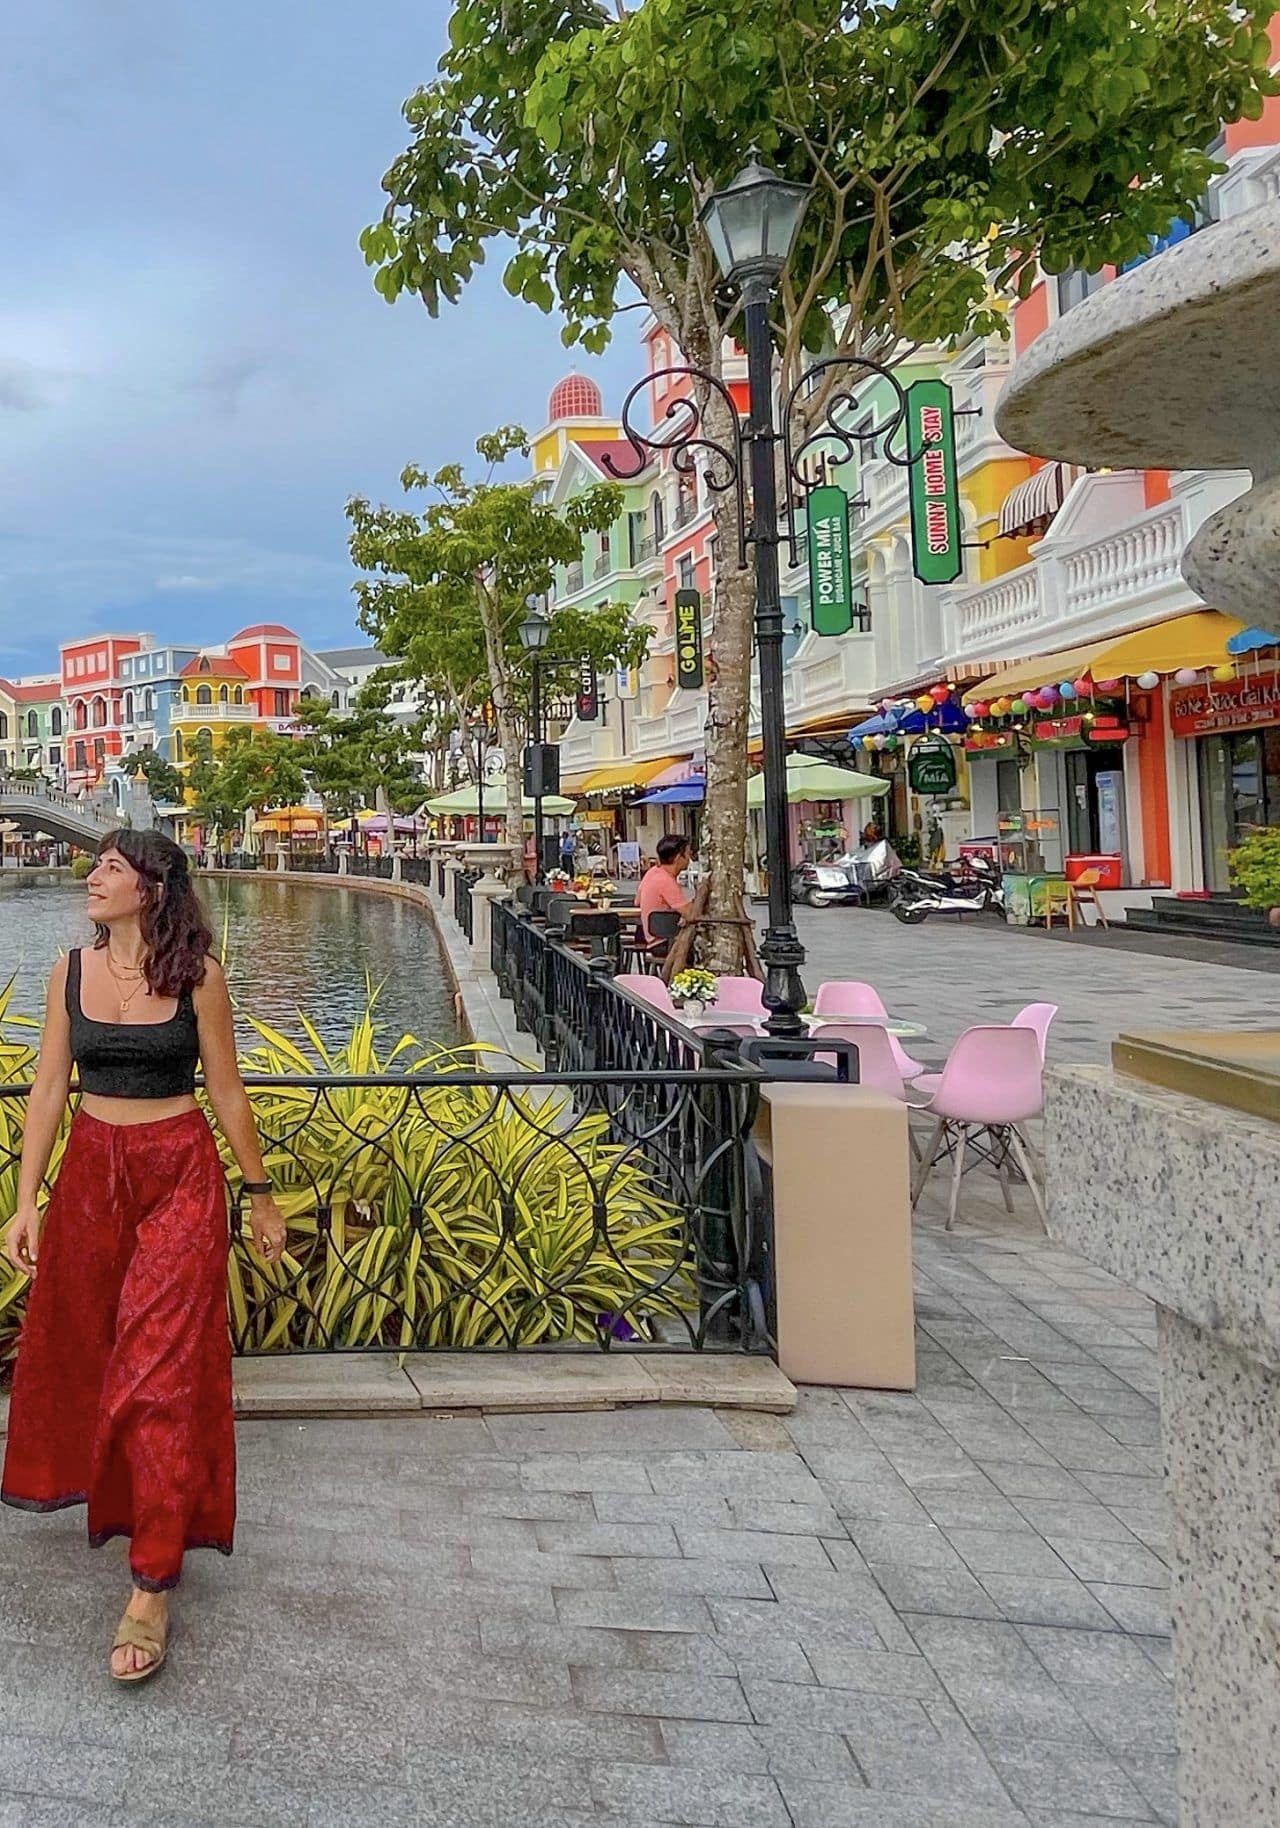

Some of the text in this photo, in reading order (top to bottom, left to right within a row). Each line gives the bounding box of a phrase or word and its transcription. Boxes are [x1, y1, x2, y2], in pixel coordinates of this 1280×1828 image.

[920, 406, 949, 555] SUNNY HOME STAY
[811, 517, 834, 605] POWER MÍA
